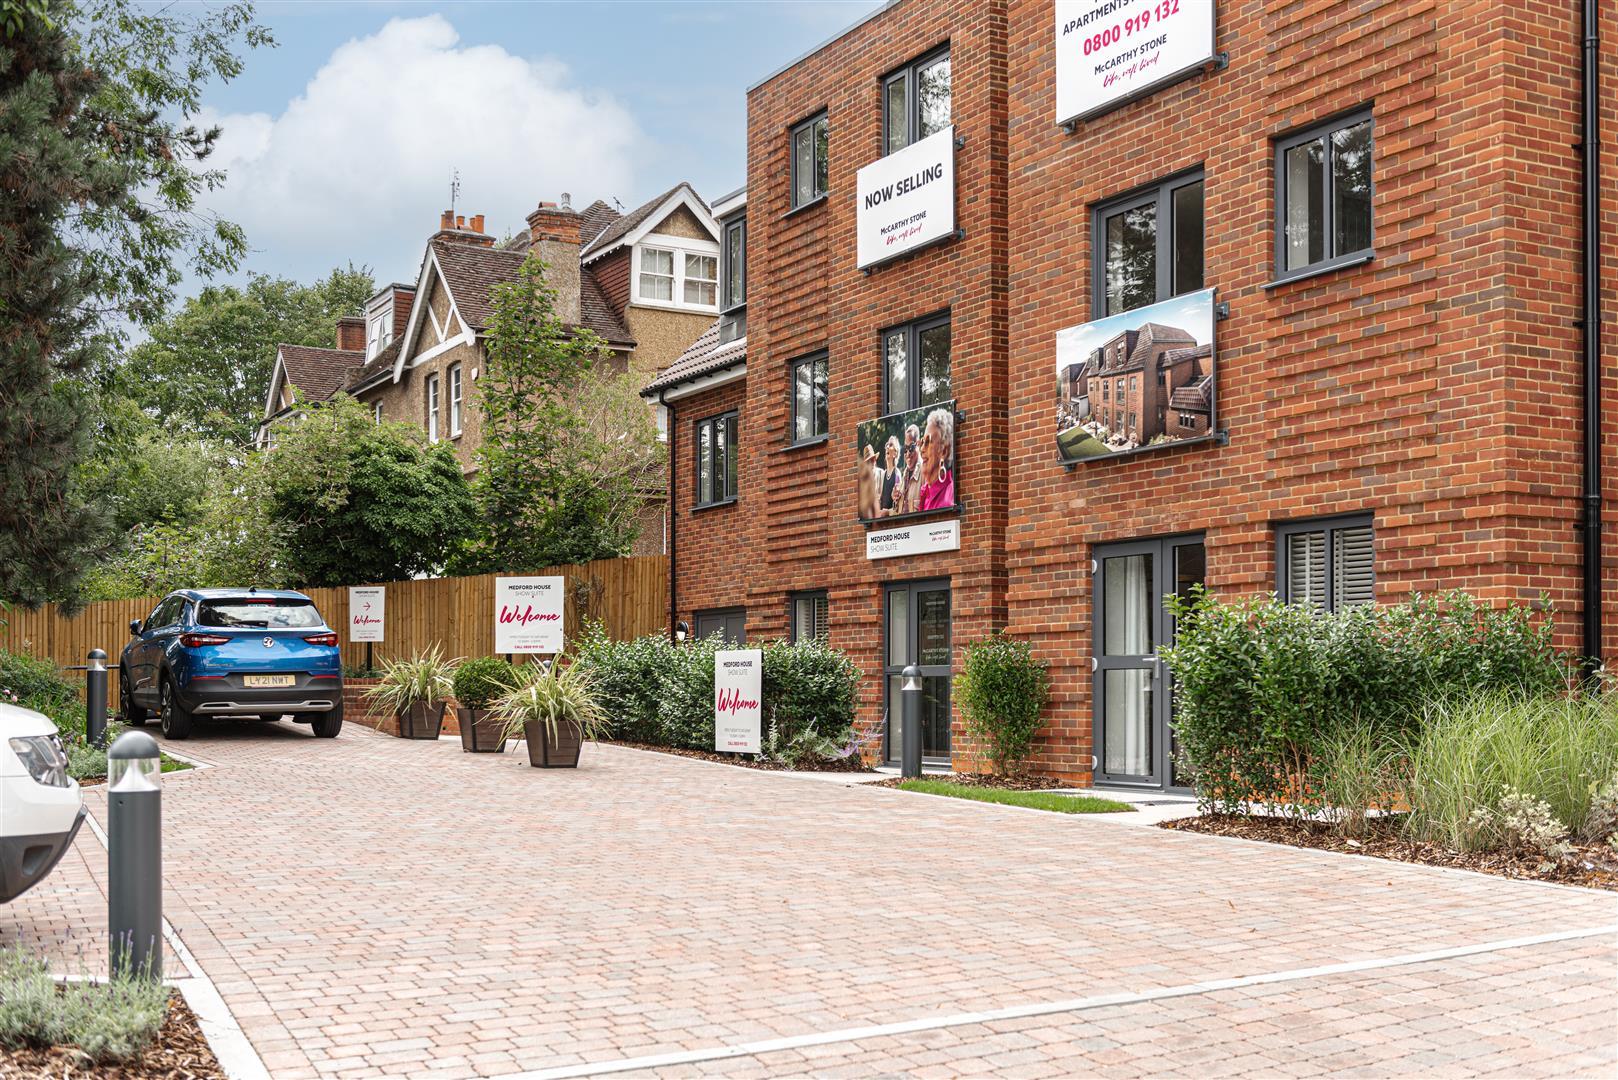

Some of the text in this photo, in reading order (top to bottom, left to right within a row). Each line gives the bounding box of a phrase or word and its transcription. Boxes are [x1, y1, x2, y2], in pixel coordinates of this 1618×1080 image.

[1083, 0, 1180, 56] 0800 919 132
[1094, 33, 1167, 76] McCARTHY STONE
[865, 163, 943, 210] NOW SELLING
[880, 210, 927, 236] McCARTHY STONE
[870, 532, 911, 543] MEDFORD HOUSE
[870, 543, 898, 553] SHOW SUITE
[353, 615, 382, 626] Welcome
[499, 604, 561, 627] Welcome
[249, 676, 289, 685] LY21 NWT
[717, 687, 759, 716] Welcome
